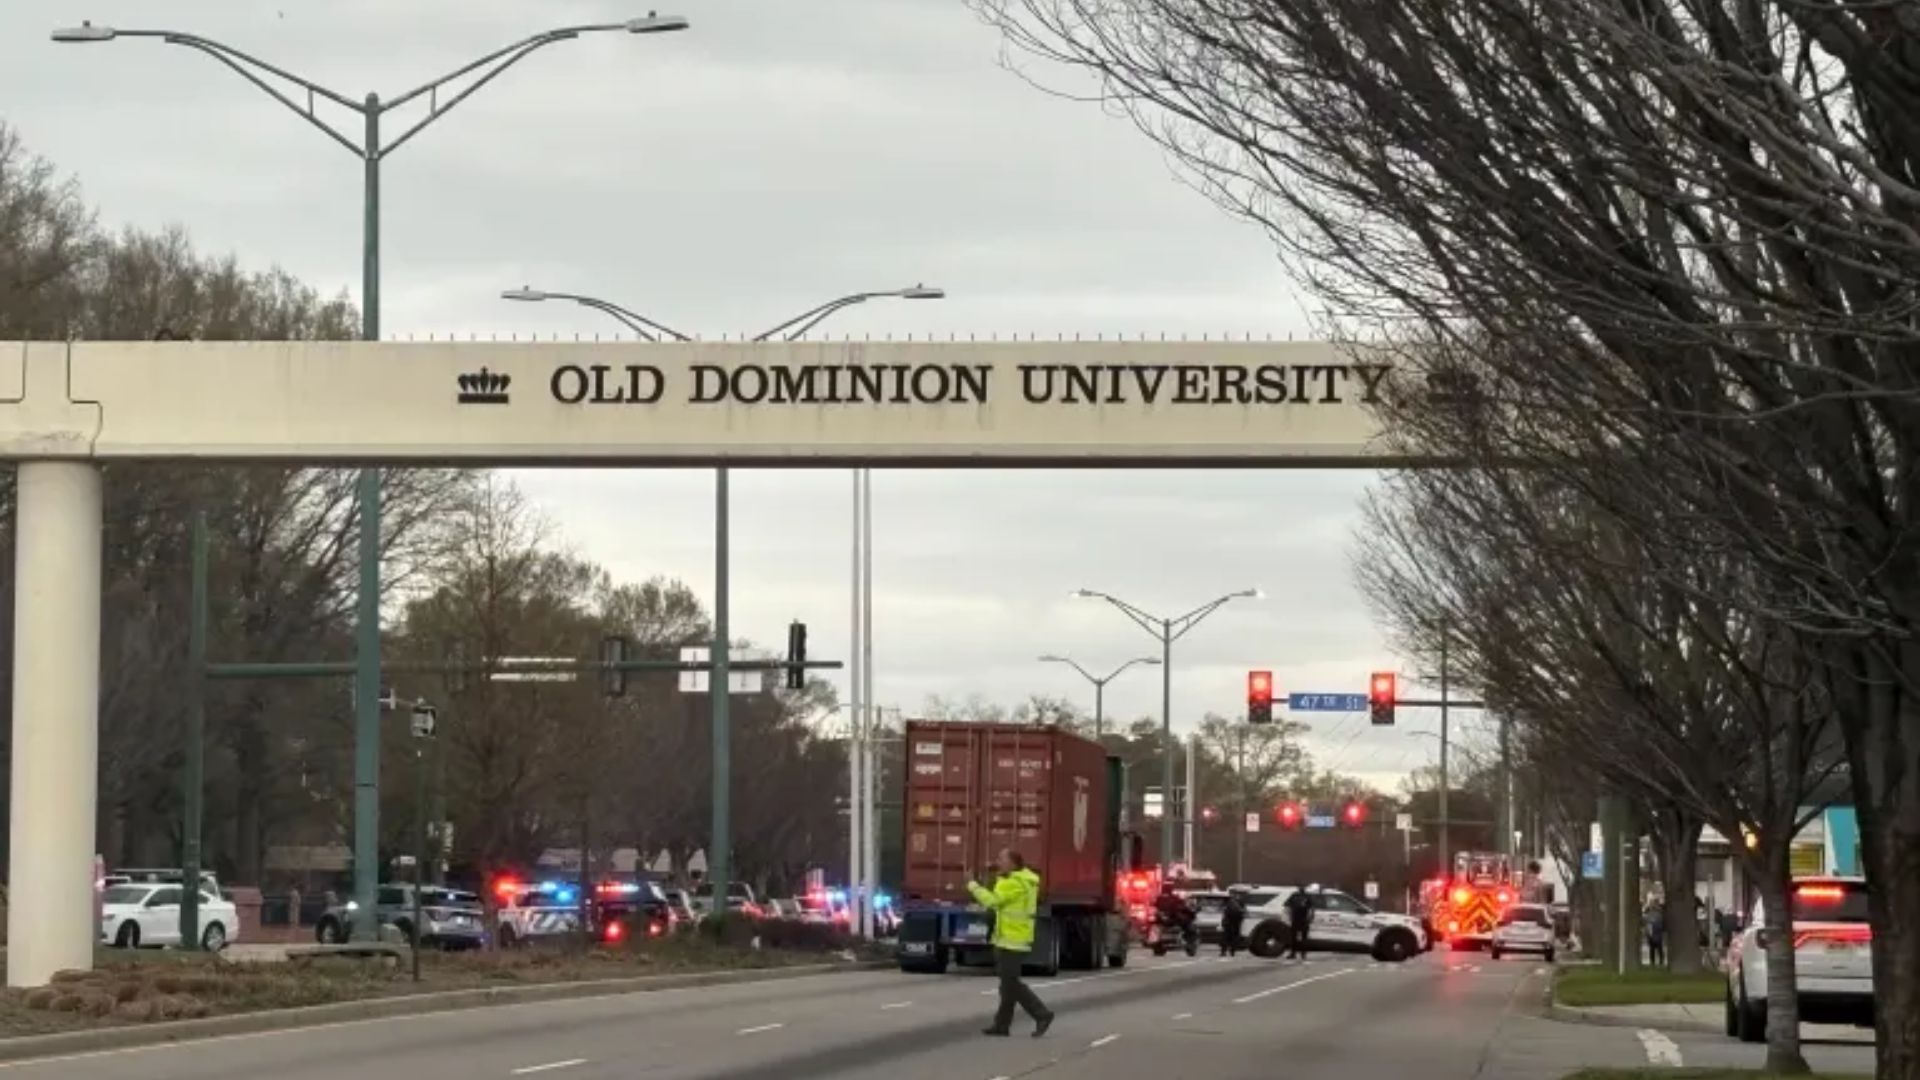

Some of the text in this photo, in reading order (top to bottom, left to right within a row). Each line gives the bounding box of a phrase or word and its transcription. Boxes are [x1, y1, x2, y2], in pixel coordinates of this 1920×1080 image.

[550, 364, 1393, 404] OLD DOMINION UNIVERSITY
